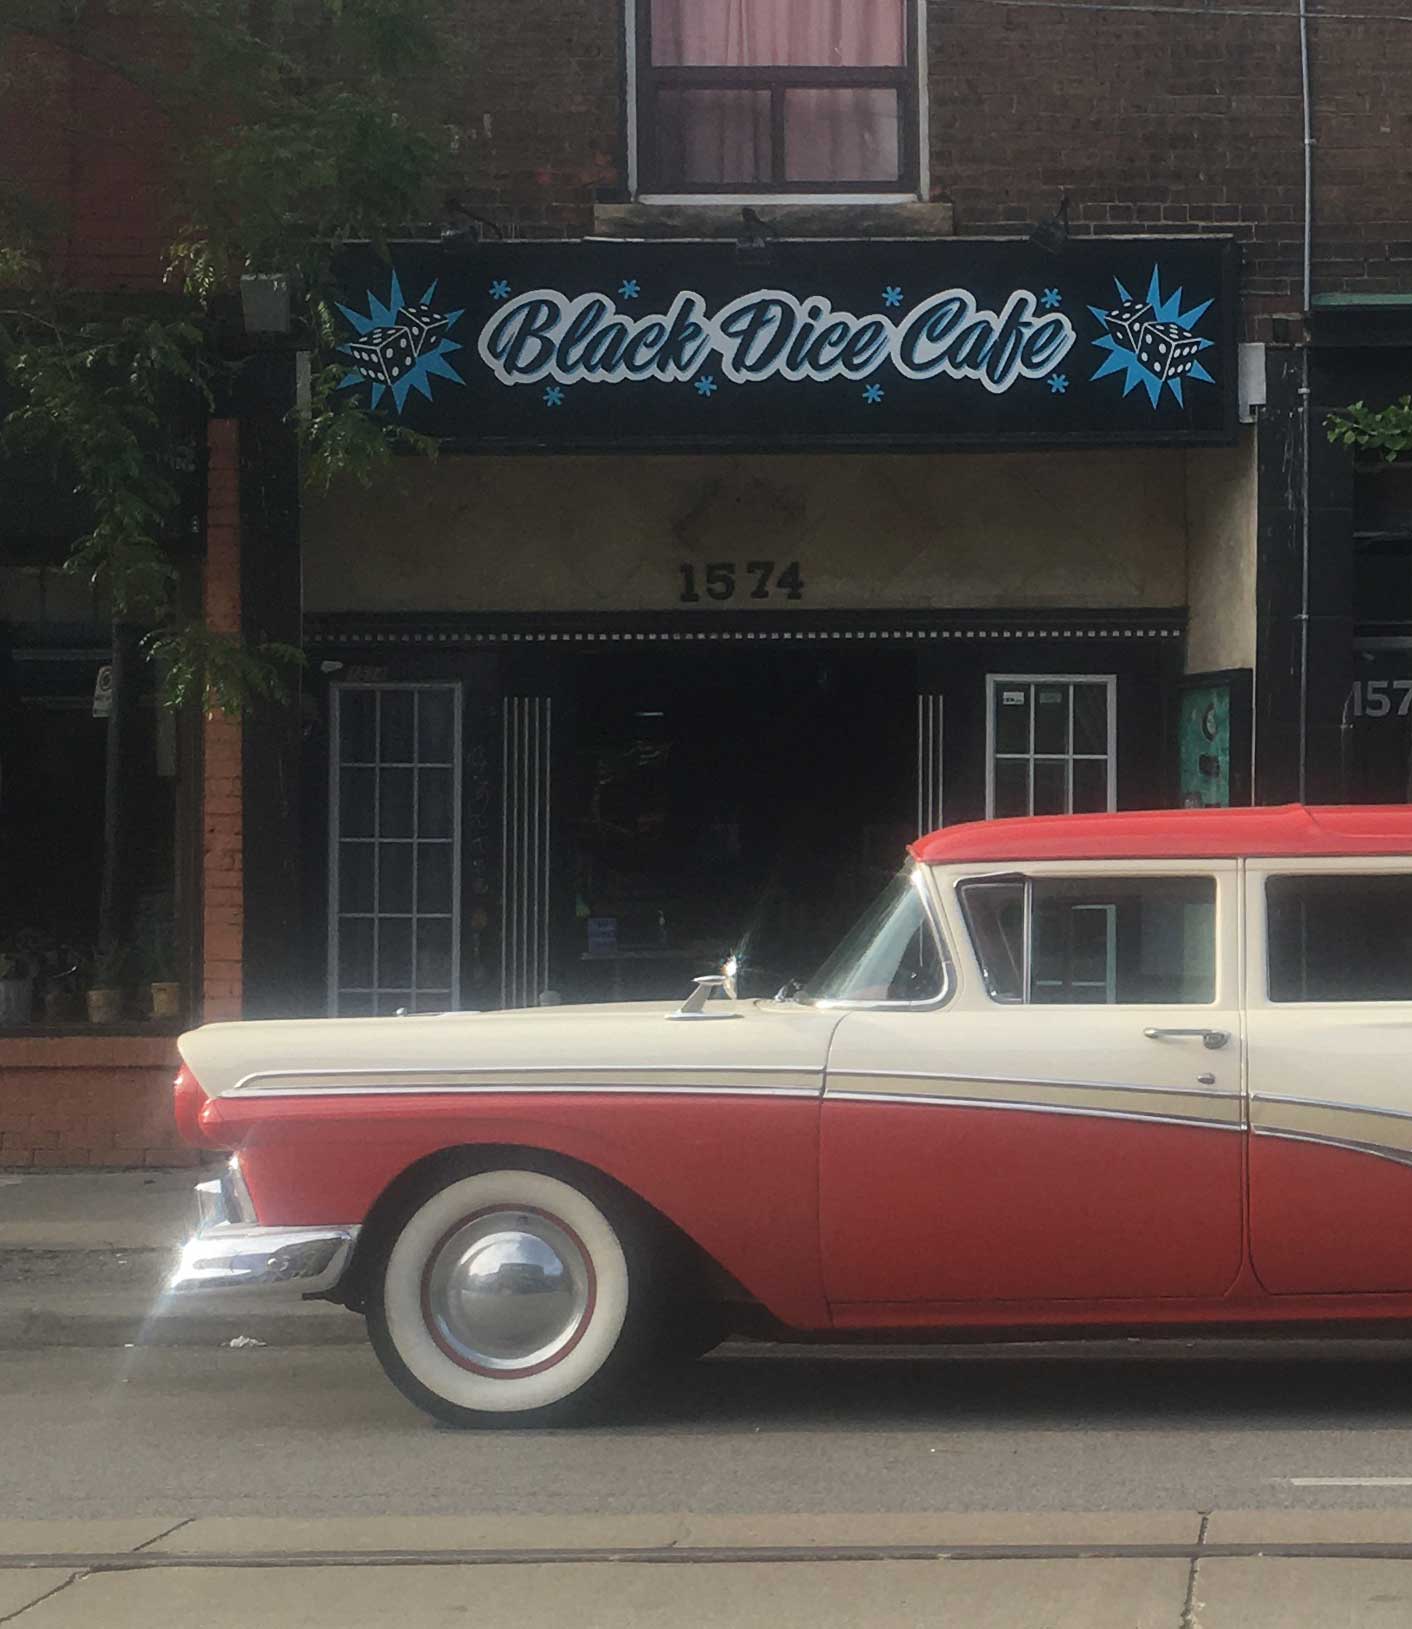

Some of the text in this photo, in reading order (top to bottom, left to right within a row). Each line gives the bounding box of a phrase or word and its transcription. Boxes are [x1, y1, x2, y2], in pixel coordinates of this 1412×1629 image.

[481, 290, 1074, 393] Black Dice Cafe
[680, 561, 804, 602] 1574
